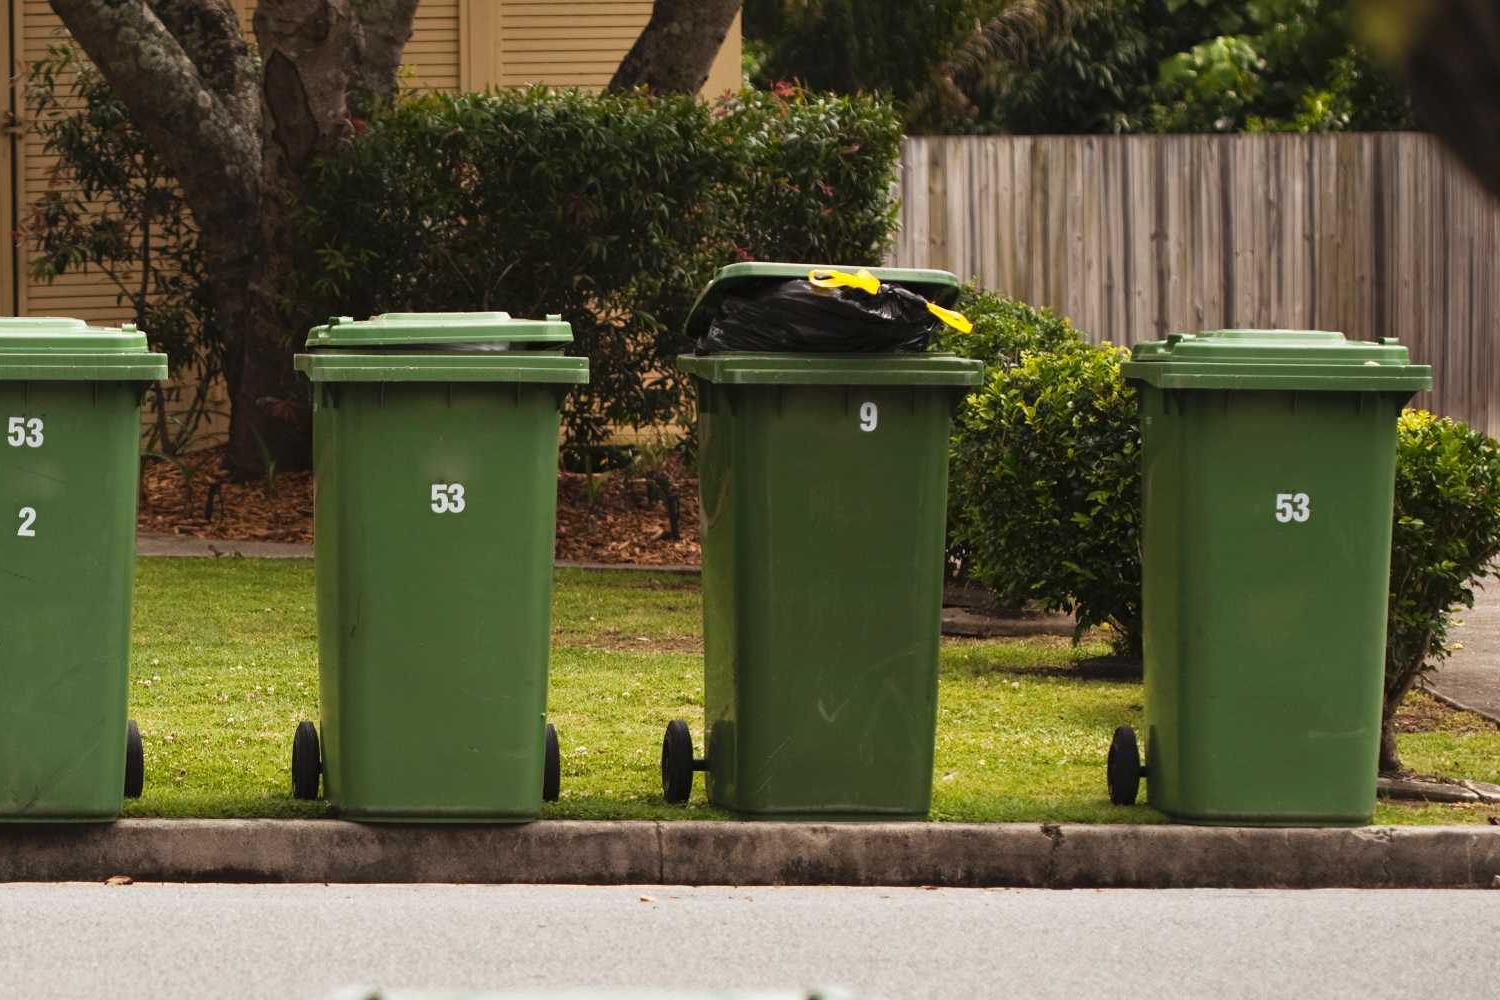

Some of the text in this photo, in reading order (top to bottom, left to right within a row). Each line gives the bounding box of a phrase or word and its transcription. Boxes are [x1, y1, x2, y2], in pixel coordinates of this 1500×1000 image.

[7, 416, 44, 449] 53
[859, 402, 878, 433] 9
[430, 483, 466, 514] 53
[1275, 492, 1311, 523] 53
[16, 506, 37, 538] 2
